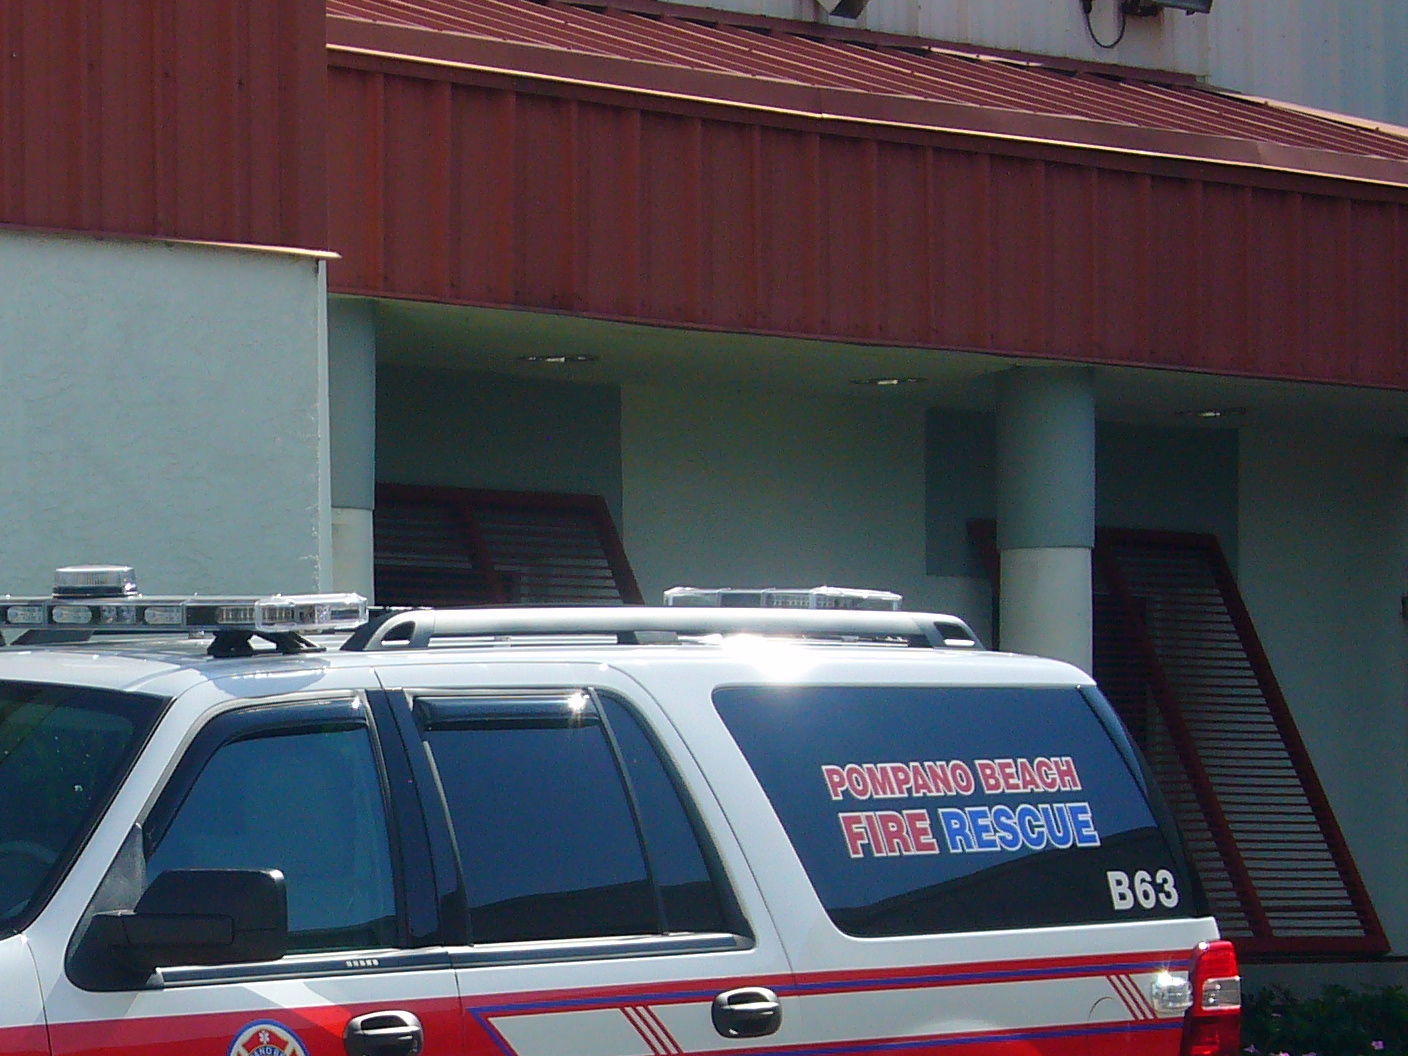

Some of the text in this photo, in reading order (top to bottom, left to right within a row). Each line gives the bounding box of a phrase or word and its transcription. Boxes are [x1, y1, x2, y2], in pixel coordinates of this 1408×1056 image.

[822, 757, 1081, 800] POMPANO BEACH
[838, 802, 1101, 858] FIRE RESCUE
[1106, 868, 1180, 911] B63
